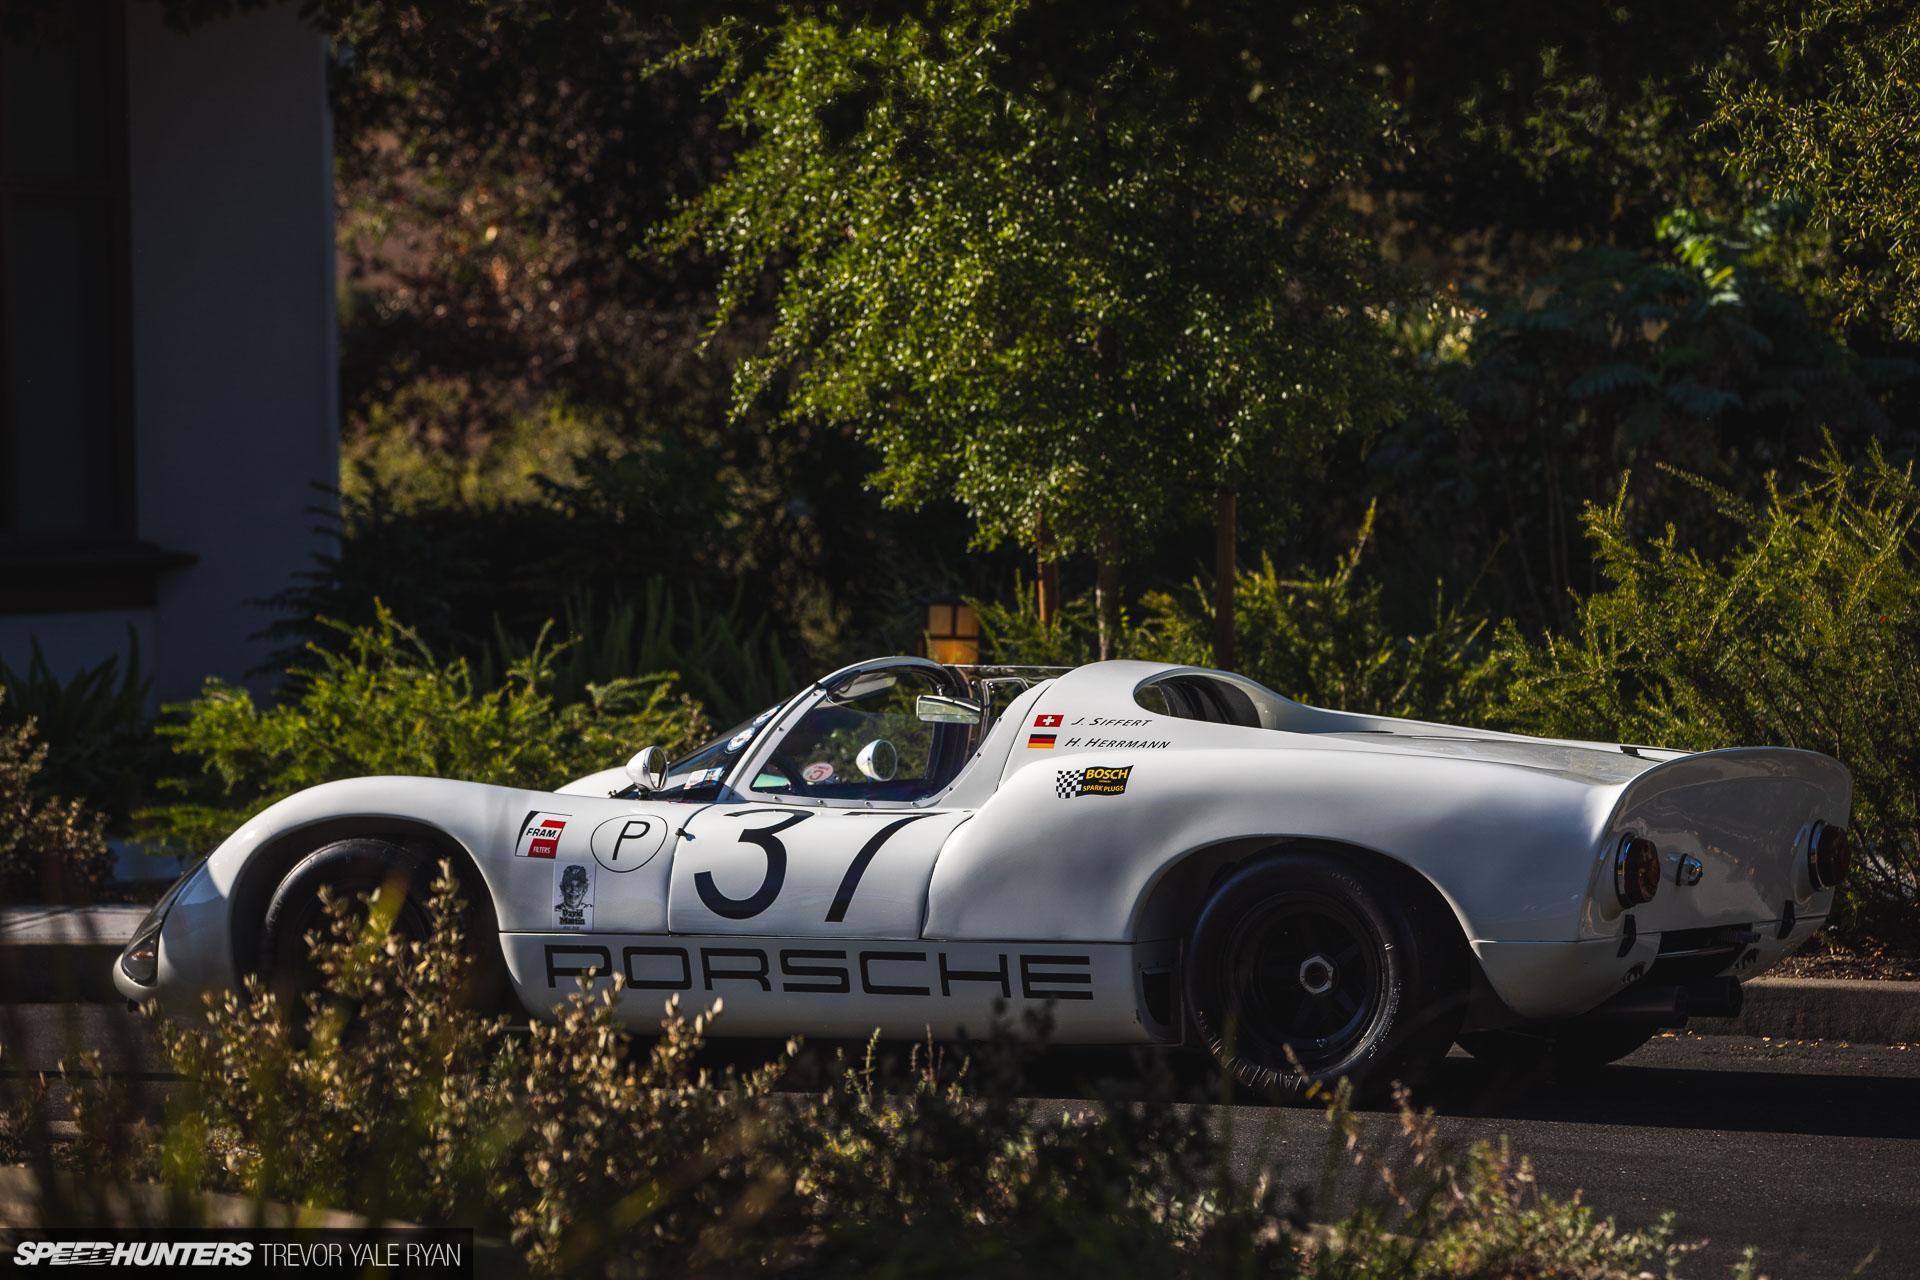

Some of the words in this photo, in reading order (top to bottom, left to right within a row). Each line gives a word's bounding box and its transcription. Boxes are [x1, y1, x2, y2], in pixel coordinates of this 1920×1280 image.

[1071, 717, 1084, 726] J.
[1088, 717, 1152, 727] SIFFERT
[1064, 737, 1081, 747] H.
[1084, 737, 1171, 749] HERRMANN
[1085, 768, 1129, 780] BOSCH
[1082, 784, 1104, 792] SPARK
[1103, 785, 1124, 793] PLUGS
[525, 827, 557, 838] FRAM
[611, 820, 651, 861] P
[532, 845, 551, 854] FILTERS
[694, 808, 950, 923] 37
[562, 909, 583, 917] David
[559, 916, 586, 925] Martin
[544, 944, 1094, 1000] PORSCHE
